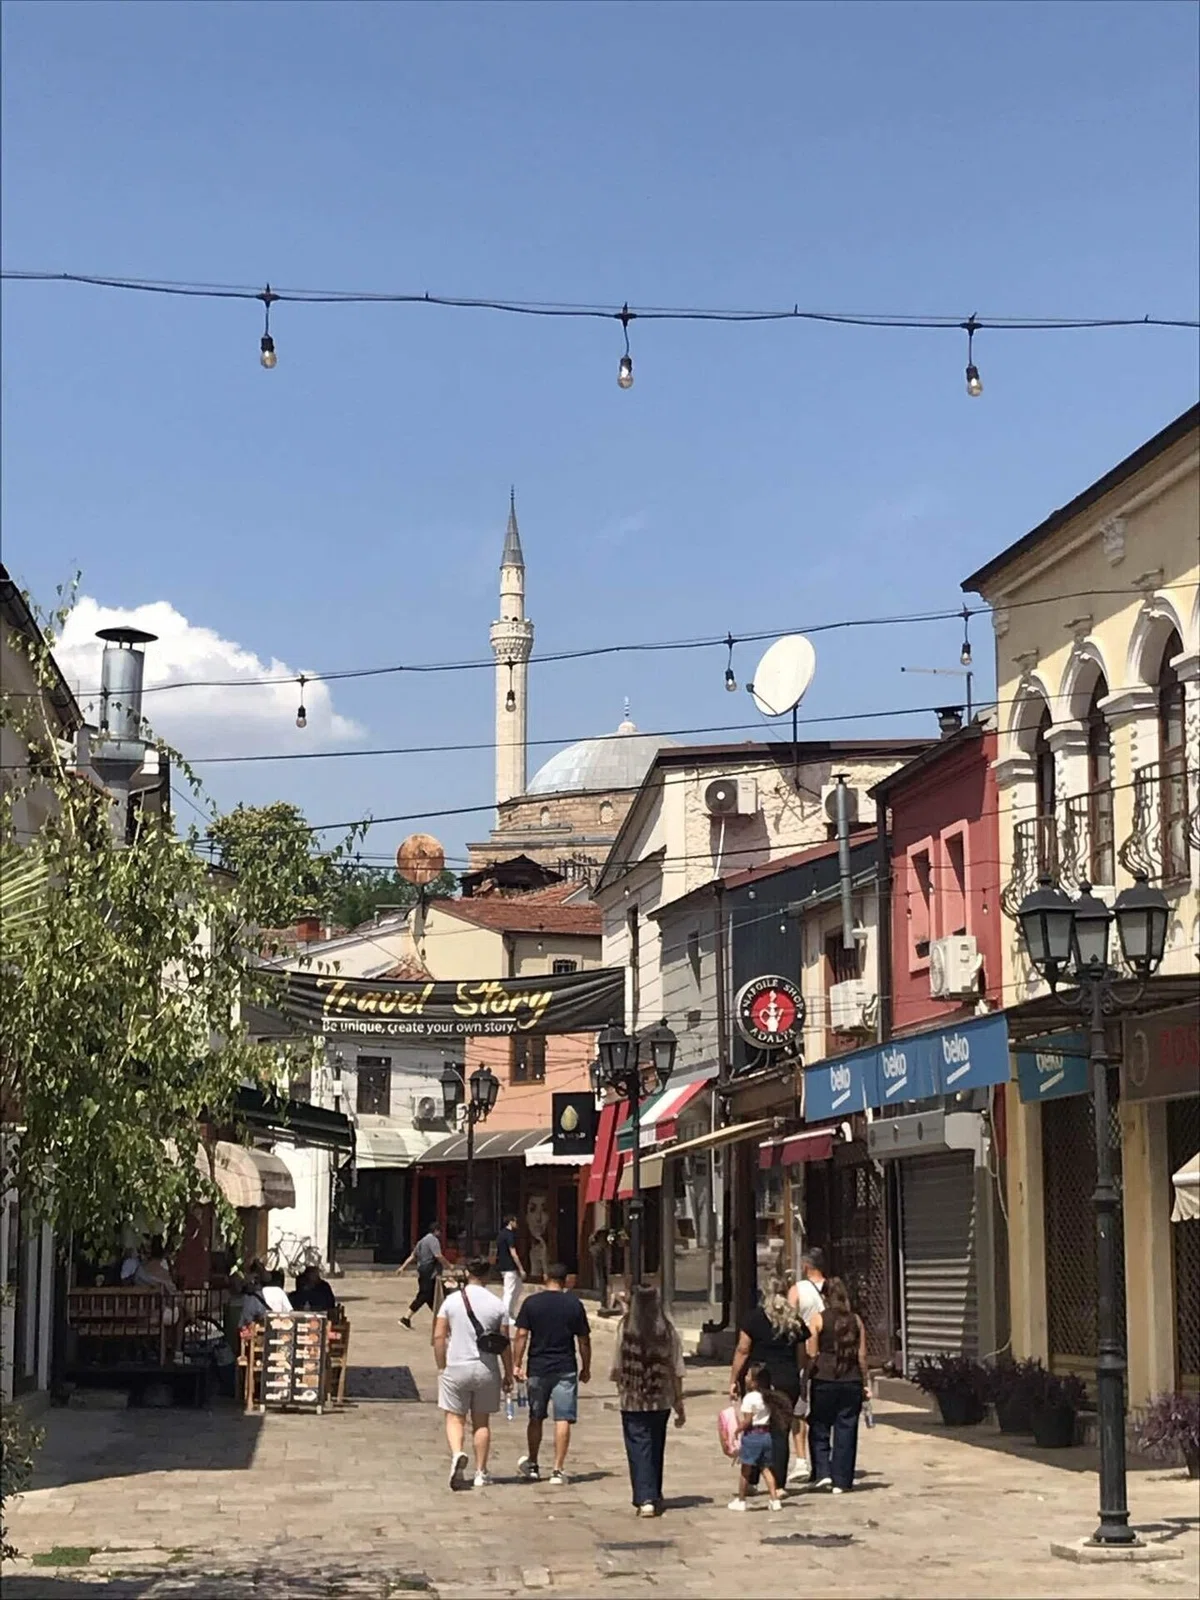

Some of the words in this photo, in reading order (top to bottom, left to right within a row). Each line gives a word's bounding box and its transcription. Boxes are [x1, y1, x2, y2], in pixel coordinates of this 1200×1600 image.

[316, 979, 435, 1016] Travel
[453, 981, 553, 1029] Story
[743, 979, 778, 1008] NARGILE
[783, 984, 804, 1010] SHOP
[322, 1021, 337, 1032] Be
[340, 1021, 385, 1034] unique,
[387, 1022, 424, 1034] create
[426, 1022, 454, 1035] your
[456, 1023, 481, 1033] own
[484, 1021, 517, 1034] story.
[882, 1049, 907, 1078] beko
[942, 1033, 970, 1064] beko
[830, 1065, 851, 1091] beko
